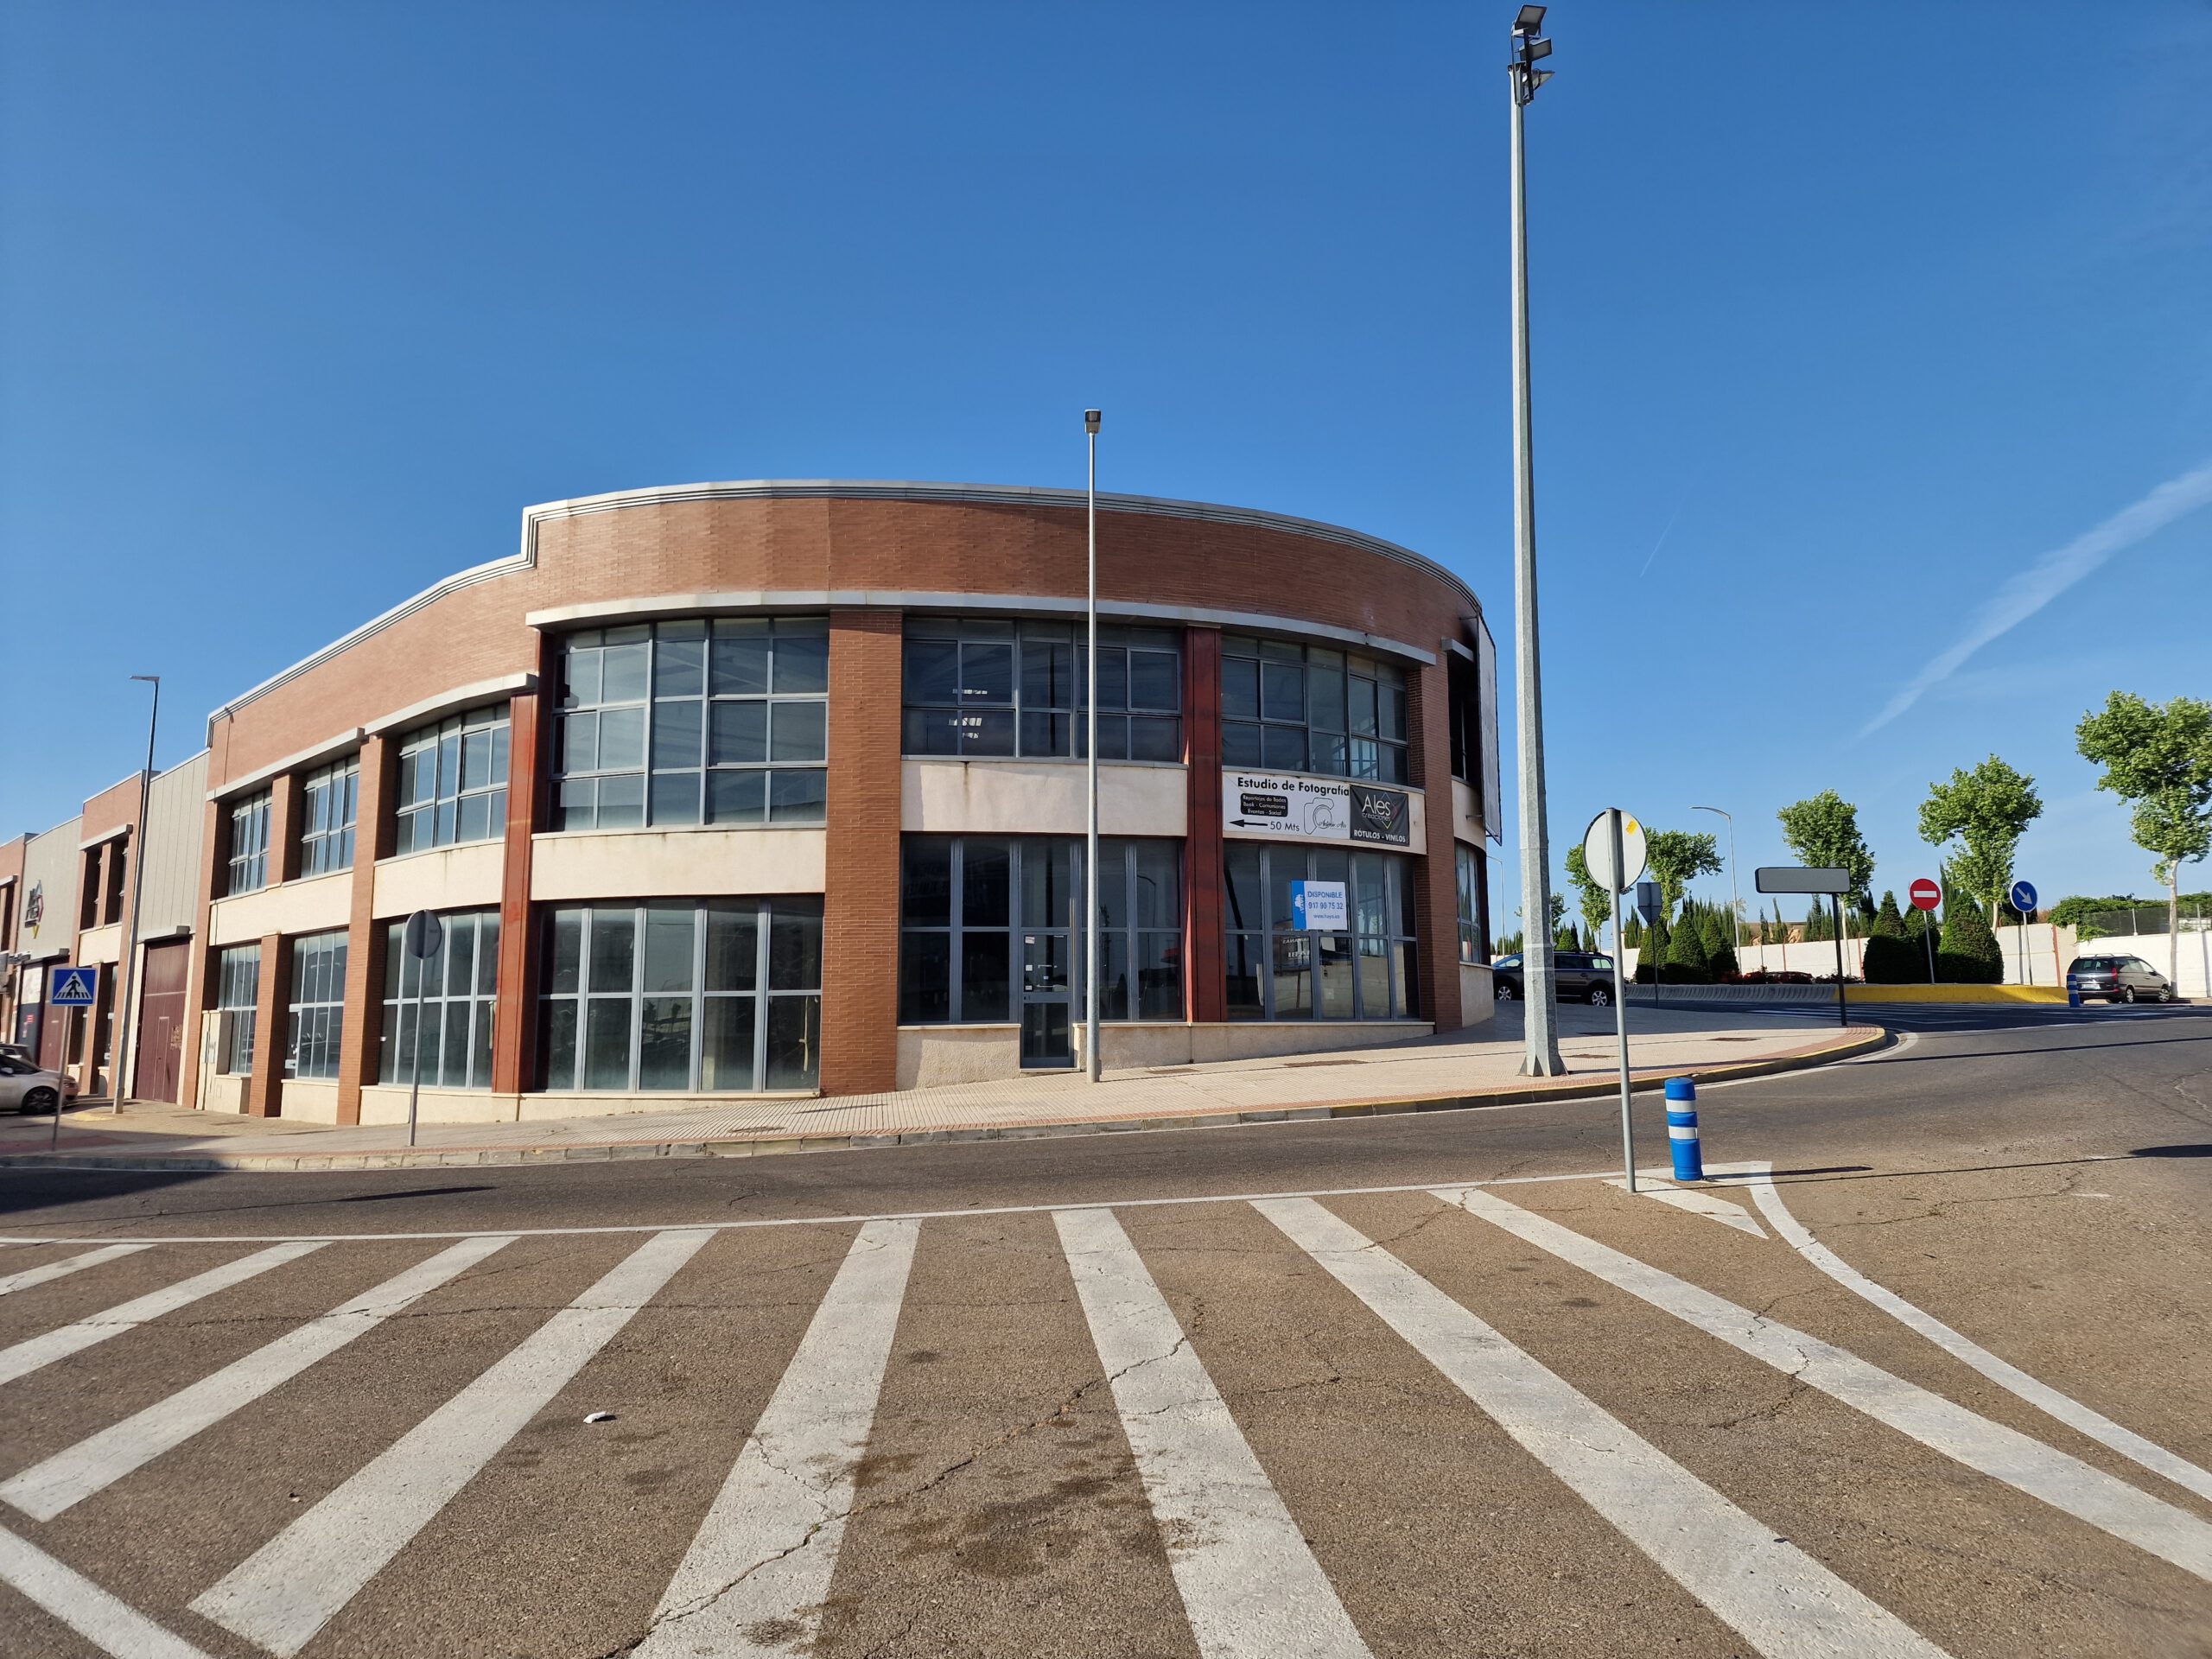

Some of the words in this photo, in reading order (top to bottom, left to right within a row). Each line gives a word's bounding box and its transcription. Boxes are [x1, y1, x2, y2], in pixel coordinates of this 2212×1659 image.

[1237, 777, 1278, 791] Estudio
[1281, 779, 1295, 791] de
[1299, 781, 1350, 797] Fotografía
[1362, 794, 1390, 816] Ales
[1362, 812, 1391, 821] creaciones
[1270, 821, 1281, 830] 50
[1285, 822, 1300, 832] Mts
[1354, 829, 1380, 839] RÓTULOS
[1385, 834, 1406, 842] VINILOS
